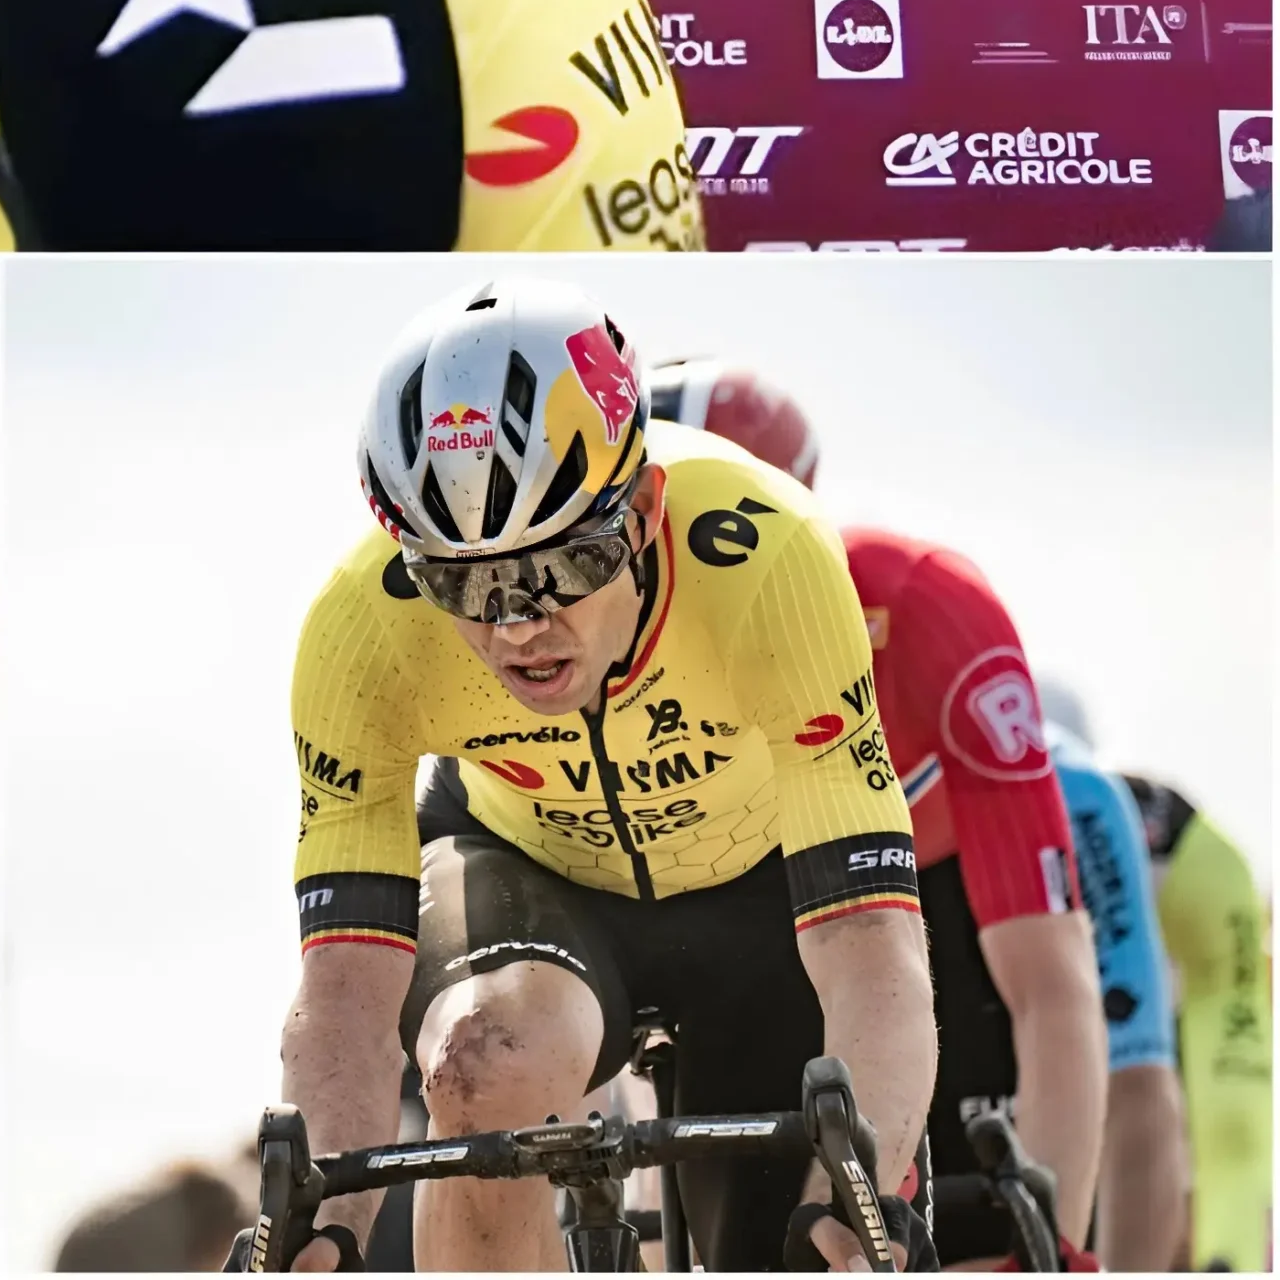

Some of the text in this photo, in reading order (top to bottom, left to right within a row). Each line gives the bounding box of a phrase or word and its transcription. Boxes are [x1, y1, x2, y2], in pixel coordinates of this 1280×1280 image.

[967, 159, 1154, 186] AGRICOLE
[428, 428, 493, 452] Red Bull
[558, 750, 735, 793] VISMA
[848, 847, 917, 872] SRA
